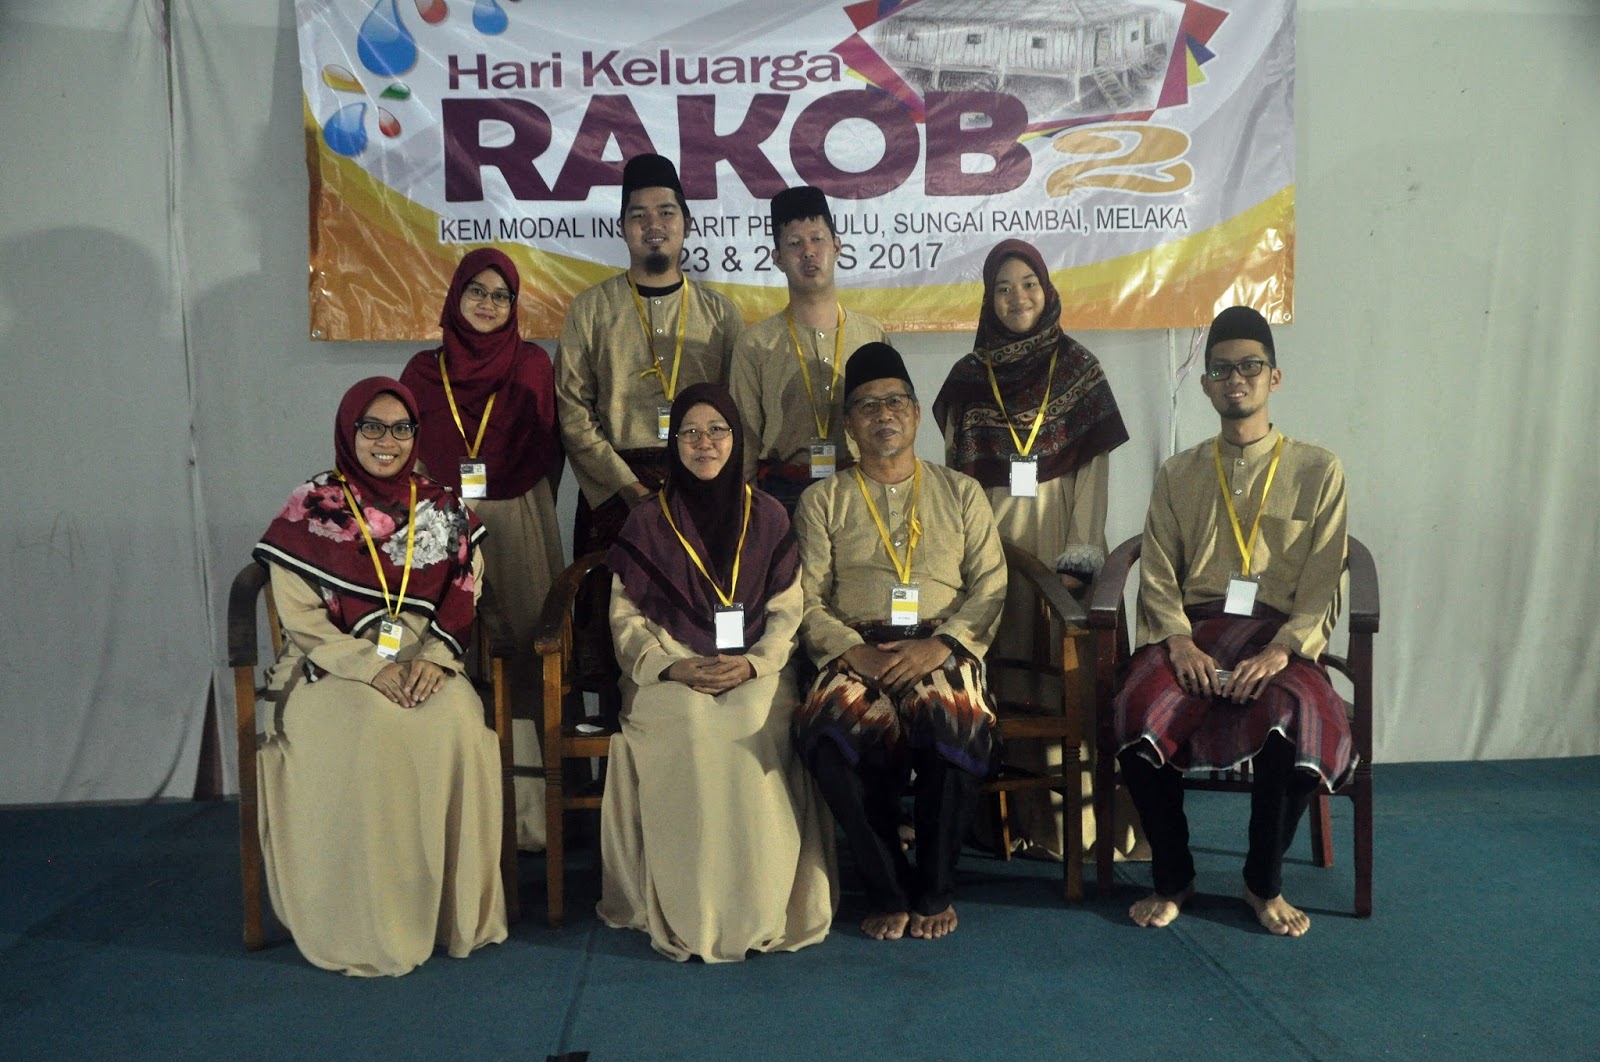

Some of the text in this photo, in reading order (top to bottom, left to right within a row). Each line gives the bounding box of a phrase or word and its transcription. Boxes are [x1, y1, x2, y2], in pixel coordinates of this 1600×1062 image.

[448, 49, 842, 91] Hari Keluarga
[441, 89, 1194, 203] RAKOB 2
[441, 218, 492, 241] KEM
[499, 217, 585, 240] MODAL
[689, 215, 740, 238] ARIT
[894, 211, 984, 234] SUNGAI
[991, 208, 1089, 233] RAMBAI,
[1096, 206, 1188, 230] MELAKA
[680, 246, 710, 273] 23
[721, 246, 743, 272] &
[754, 245, 772, 271] 2
[869, 242, 944, 270] 2017
